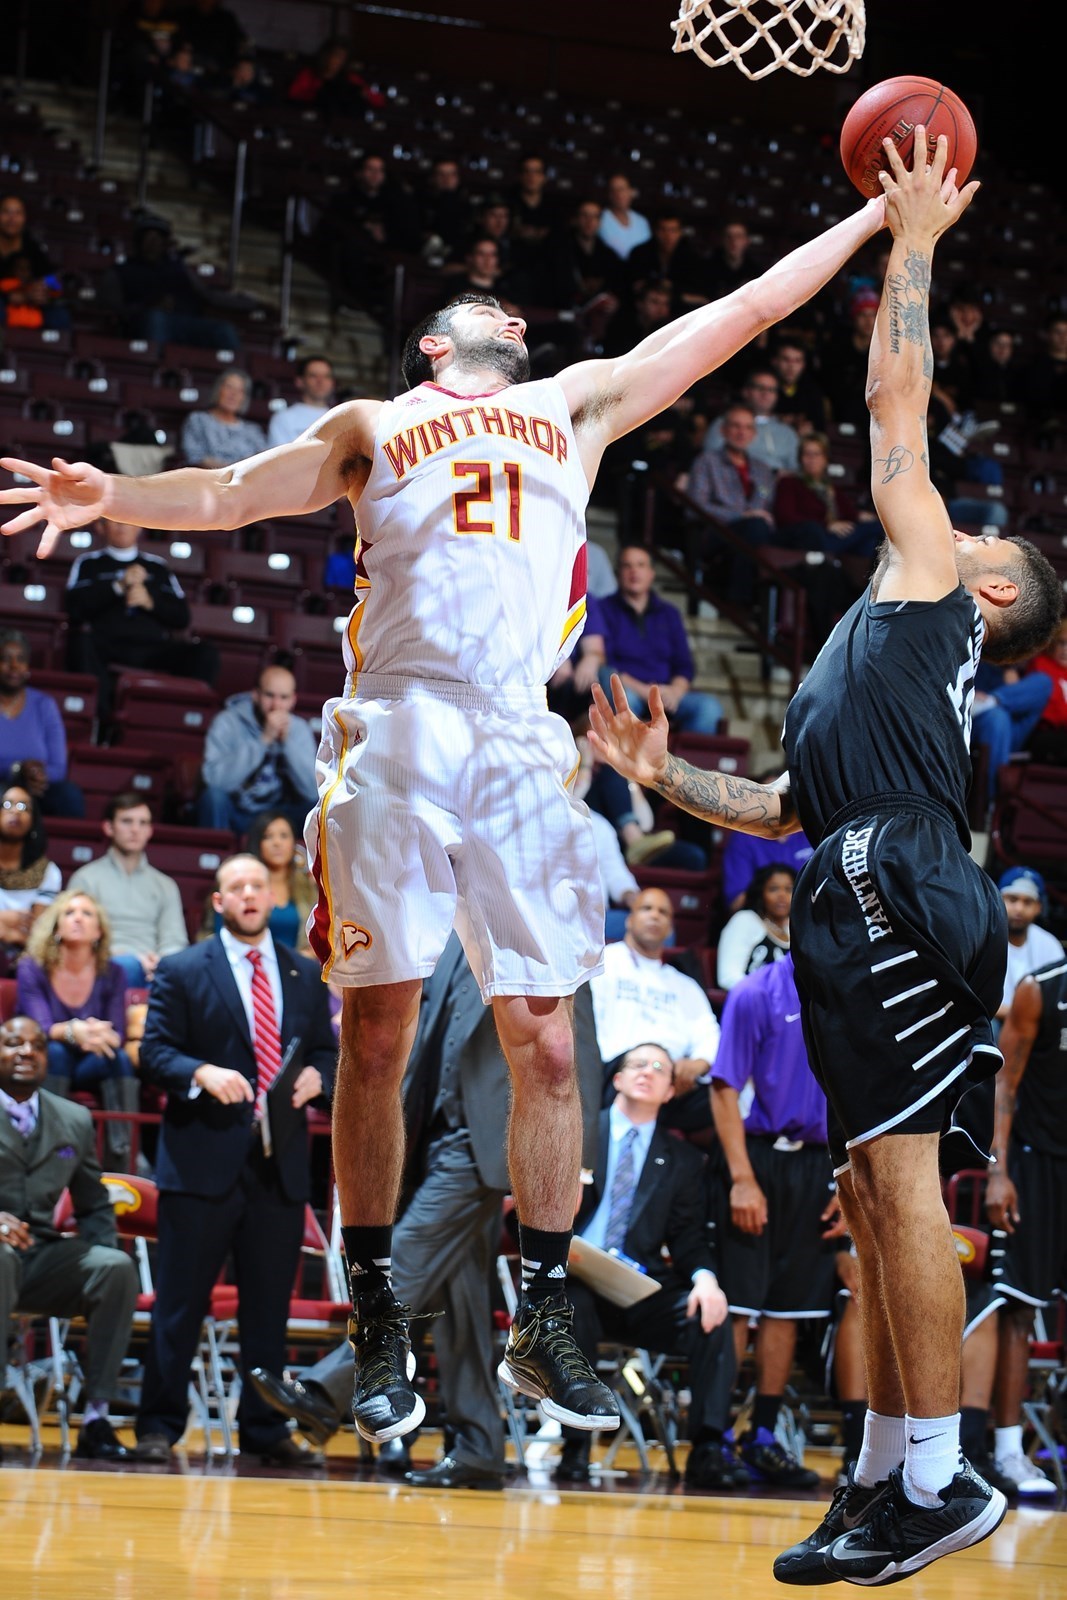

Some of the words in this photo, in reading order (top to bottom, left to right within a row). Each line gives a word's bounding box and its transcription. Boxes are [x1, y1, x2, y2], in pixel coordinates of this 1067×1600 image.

[887, 274, 907, 354] Dedication
[381, 405, 568, 483] WINTHROP
[451, 460, 521, 543] 21
[842, 828, 893, 942] PANTHERS
